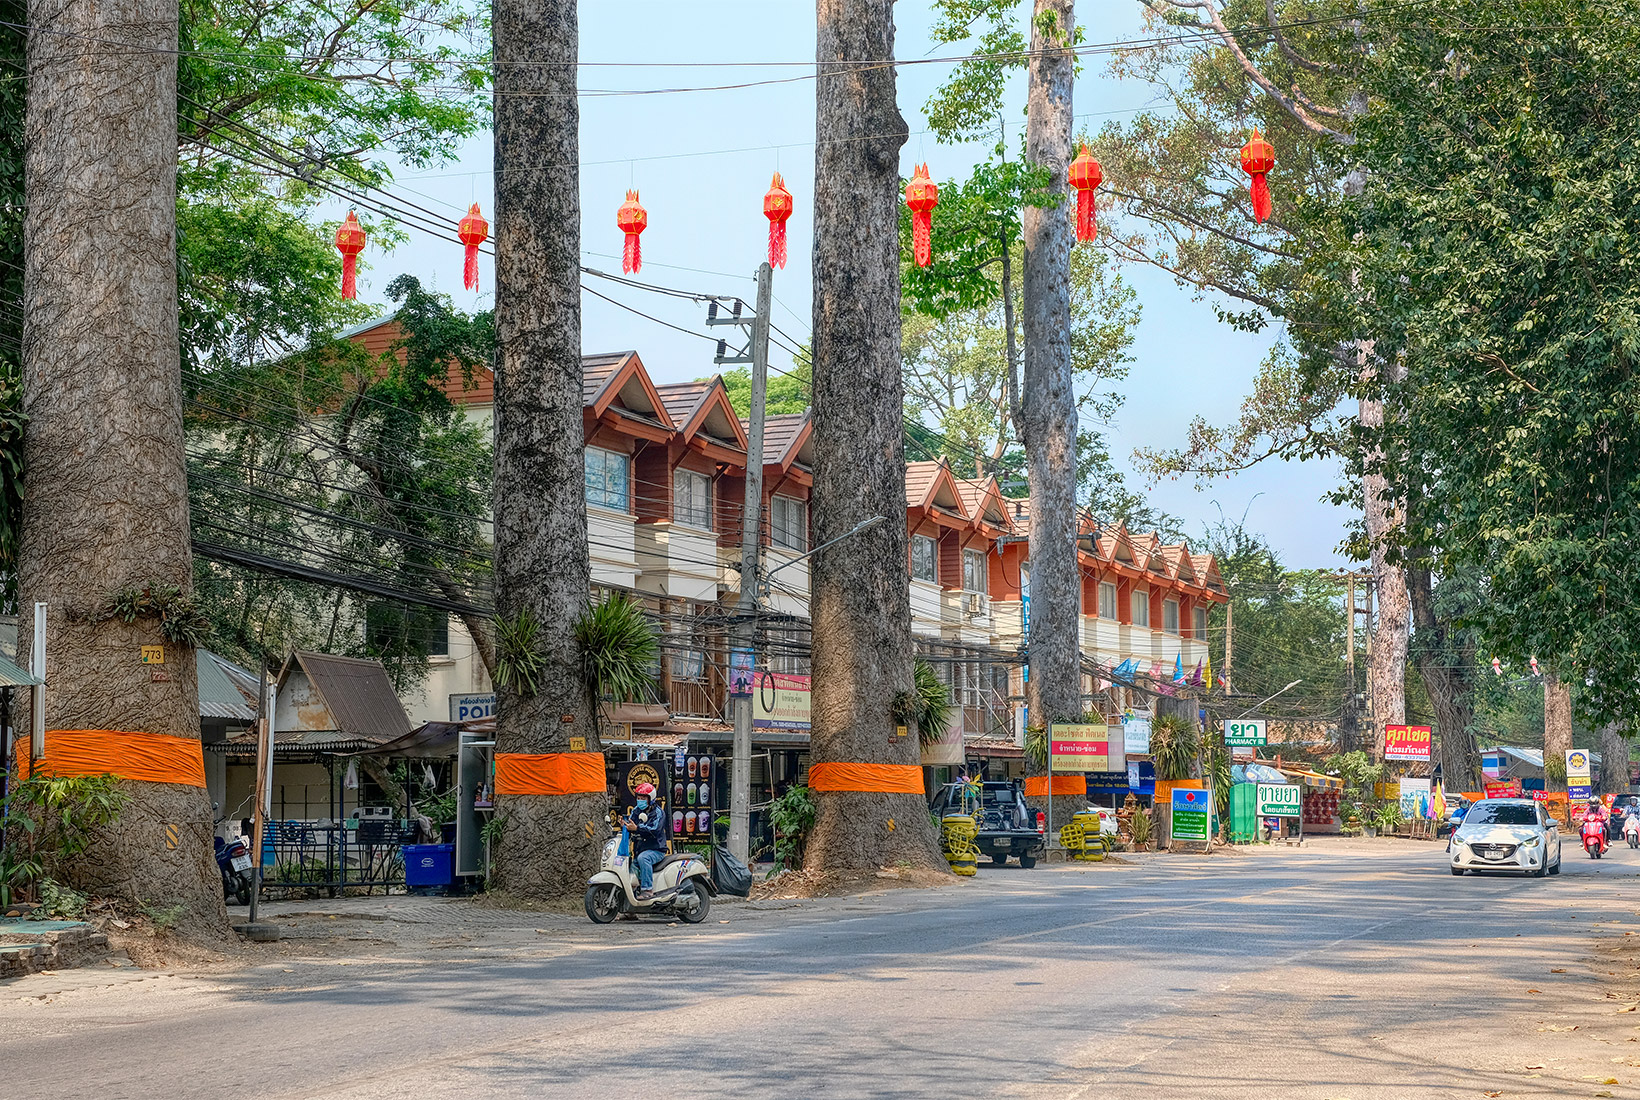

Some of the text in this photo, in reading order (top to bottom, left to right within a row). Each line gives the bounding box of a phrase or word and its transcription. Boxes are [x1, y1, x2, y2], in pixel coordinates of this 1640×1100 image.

[144, 650, 162, 660] 773
[1230, 723, 1258, 737] ยา
[1386, 725, 1430, 746] ศุภโชค
[1059, 743, 1097, 752] จำหน่าย-ซ่อม
[1259, 786, 1299, 803] ขายยา
[1534, 790, 1548, 800] ข้าว
